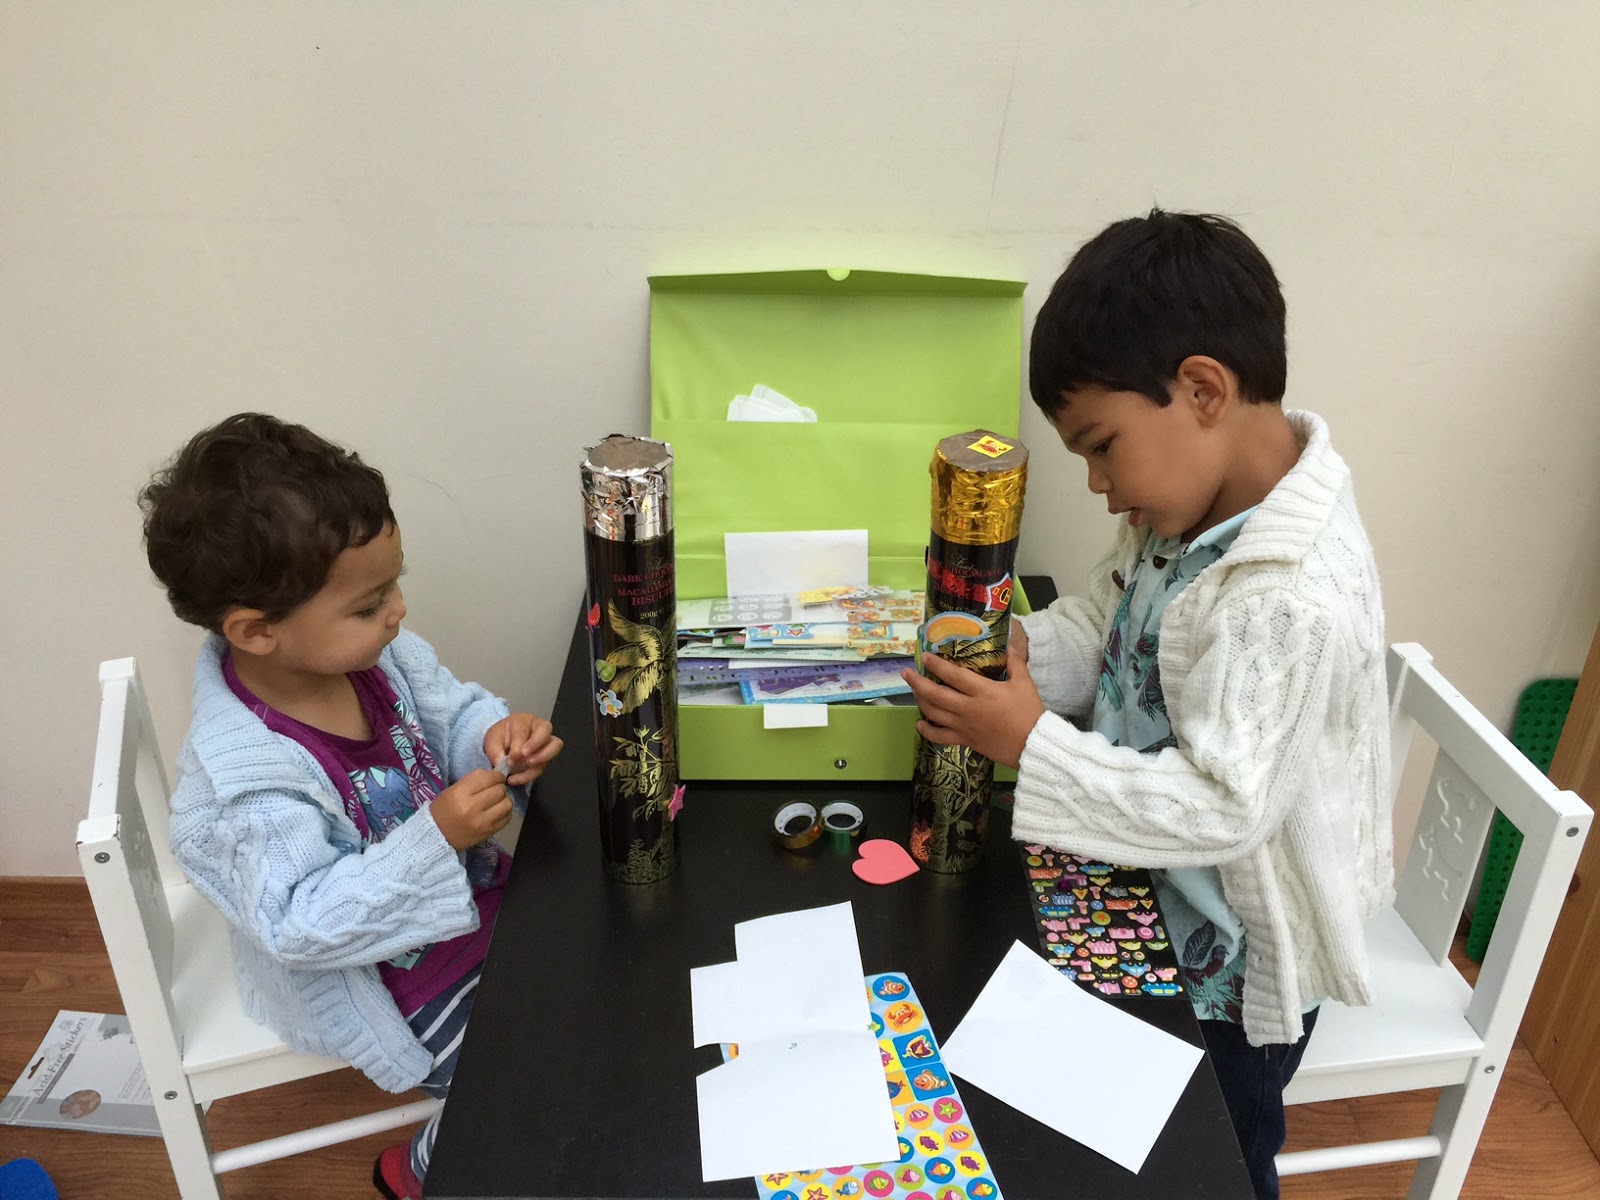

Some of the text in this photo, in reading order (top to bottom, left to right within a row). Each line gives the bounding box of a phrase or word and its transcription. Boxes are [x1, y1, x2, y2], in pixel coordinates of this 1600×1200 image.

[614, 575, 642, 583] DARK
[639, 610, 659, 620] 200g
[32, 1053, 65, 1096] Acid-Free
[60, 1016, 88, 1056] Stickers
